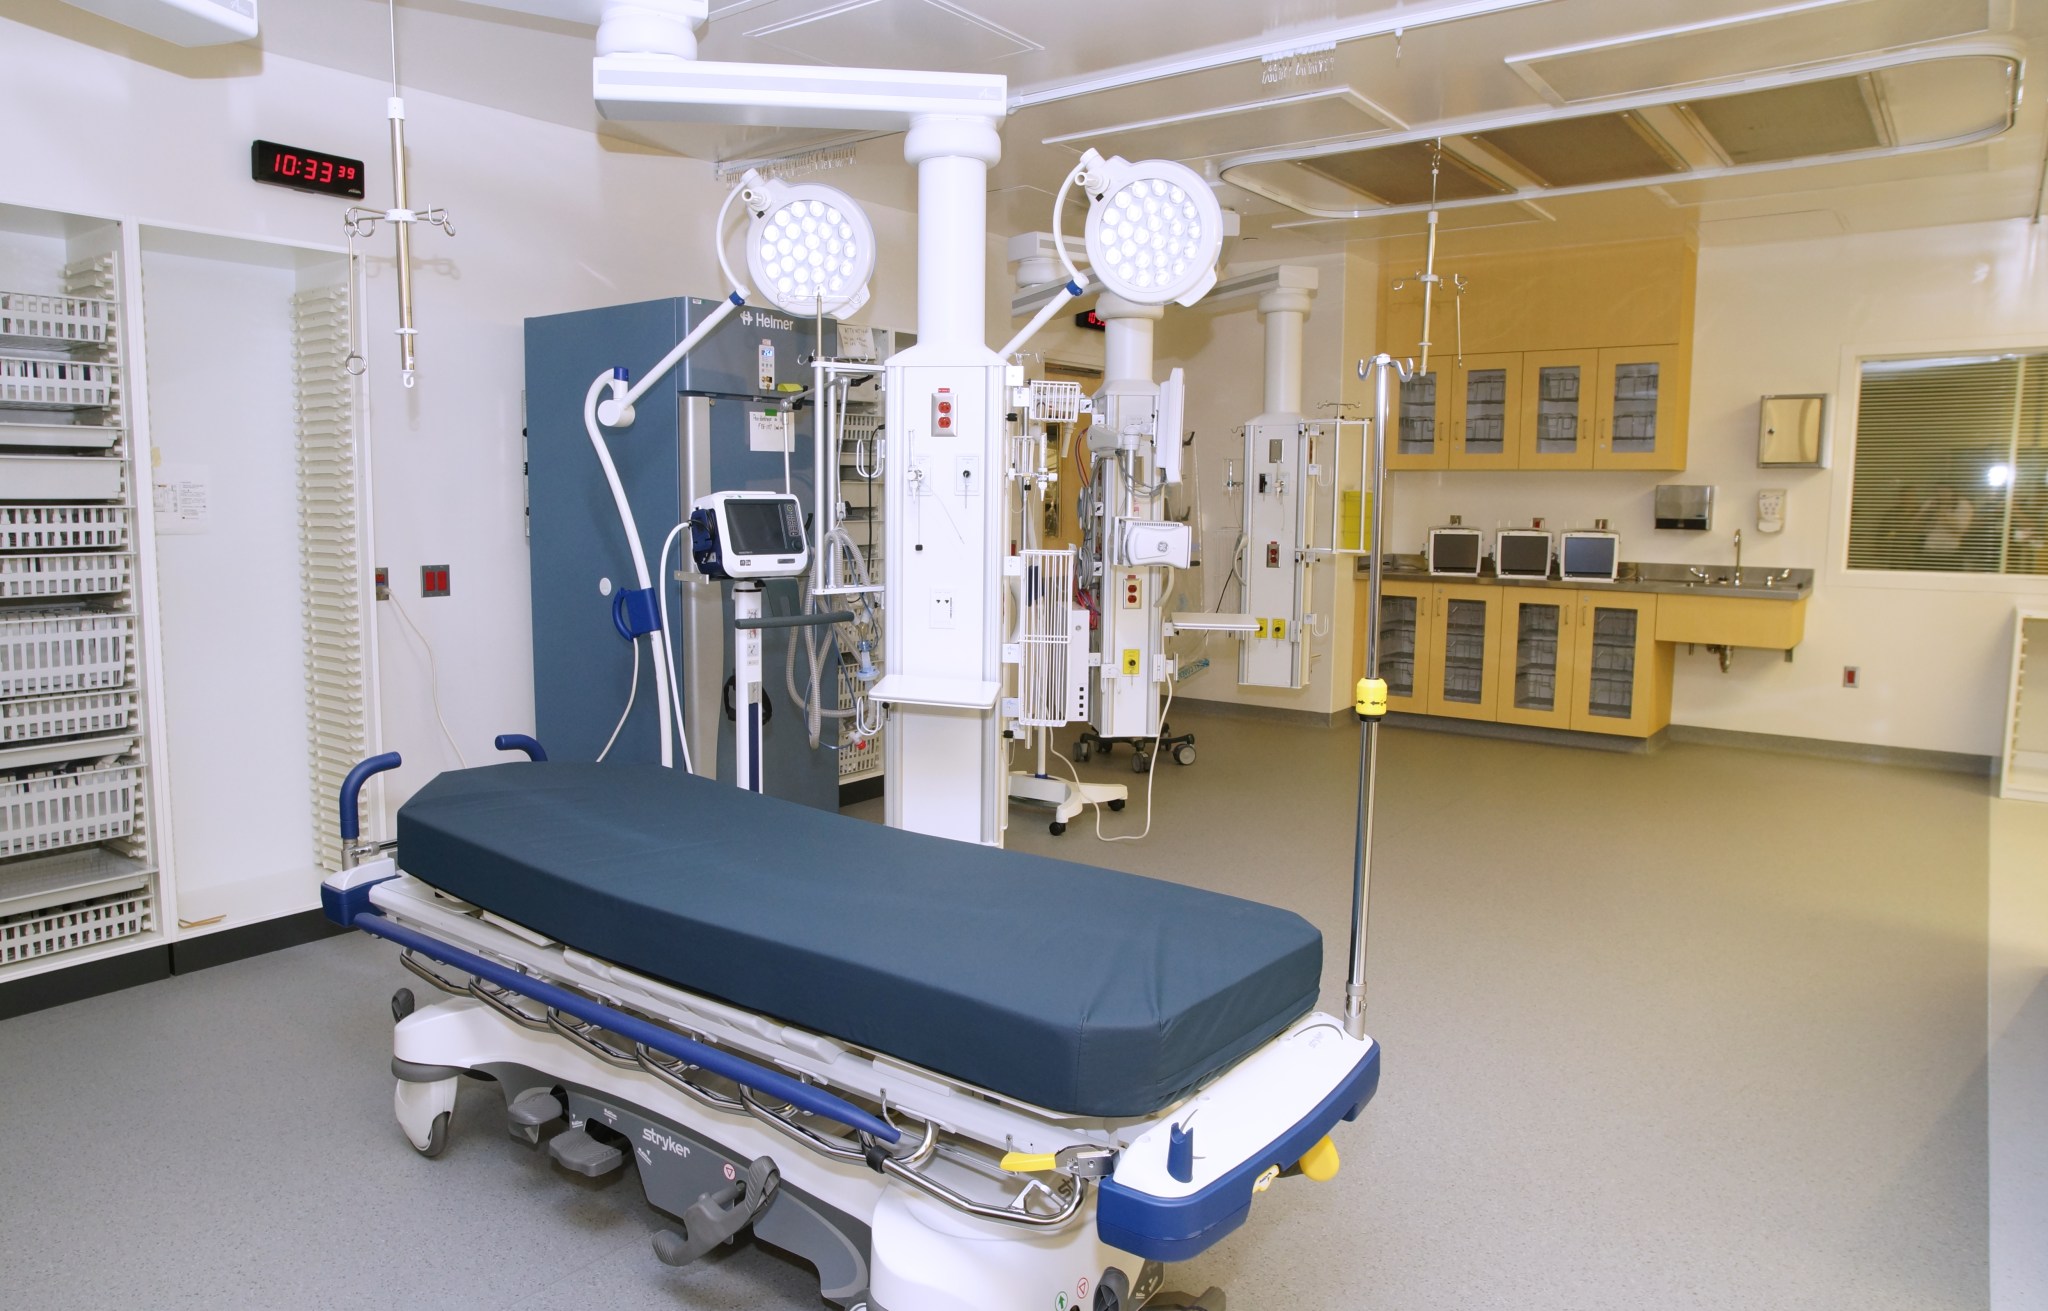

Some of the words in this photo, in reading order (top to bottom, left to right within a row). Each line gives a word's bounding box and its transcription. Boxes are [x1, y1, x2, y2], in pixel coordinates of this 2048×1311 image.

[274, 153, 333, 183] 10:33
[338, 165, 356, 180] 39
[755, 312, 794, 331] Helmer
[642, 1127, 691, 1159] stryker
